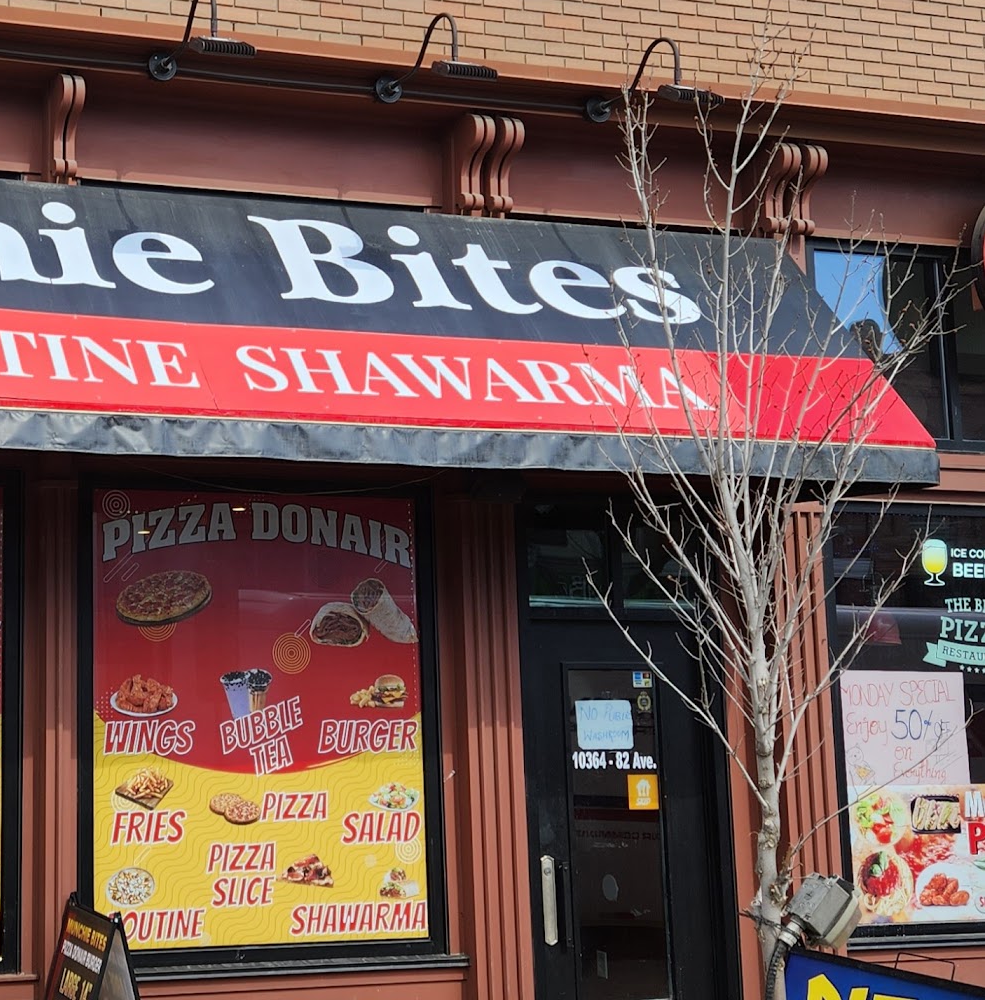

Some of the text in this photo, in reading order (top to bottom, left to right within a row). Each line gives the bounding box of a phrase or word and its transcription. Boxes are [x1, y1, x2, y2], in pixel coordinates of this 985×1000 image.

[247, 214, 701, 324] Bites
[235, 344, 716, 412] SHAWARMA
[102, 503, 413, 569] PIZZA DONAIR
[950, 548, 967, 558] ICE
[952, 562, 985, 579] BEE
[945, 597, 972, 613] THE
[840, 679, 956, 707] MONDAY SPECIAL
[219, 696, 304, 755] BUBBLE
[580, 706, 598, 721] NO
[846, 712, 888, 745] Enjoy
[891, 709, 933, 741] 50%
[103, 719, 195, 756] WINGS
[318, 719, 418, 754] BURGER
[894, 746, 912, 761] on
[249, 735, 294, 777] TEA
[572, 752, 606, 770] 10364
[616, 752, 630, 770] 82
[633, 752, 657, 770] Ave.
[260, 791, 330, 822] PIZZA
[111, 810, 187, 846] FRIES
[340, 811, 422, 845] SALAD
[206, 842, 276, 874] PIZZA
[211, 876, 276, 908] SLICE
[108, 908, 205, 943] OUTINE
[290, 901, 427, 937] SHAWARMA
[89, 930, 108, 952] BITES
